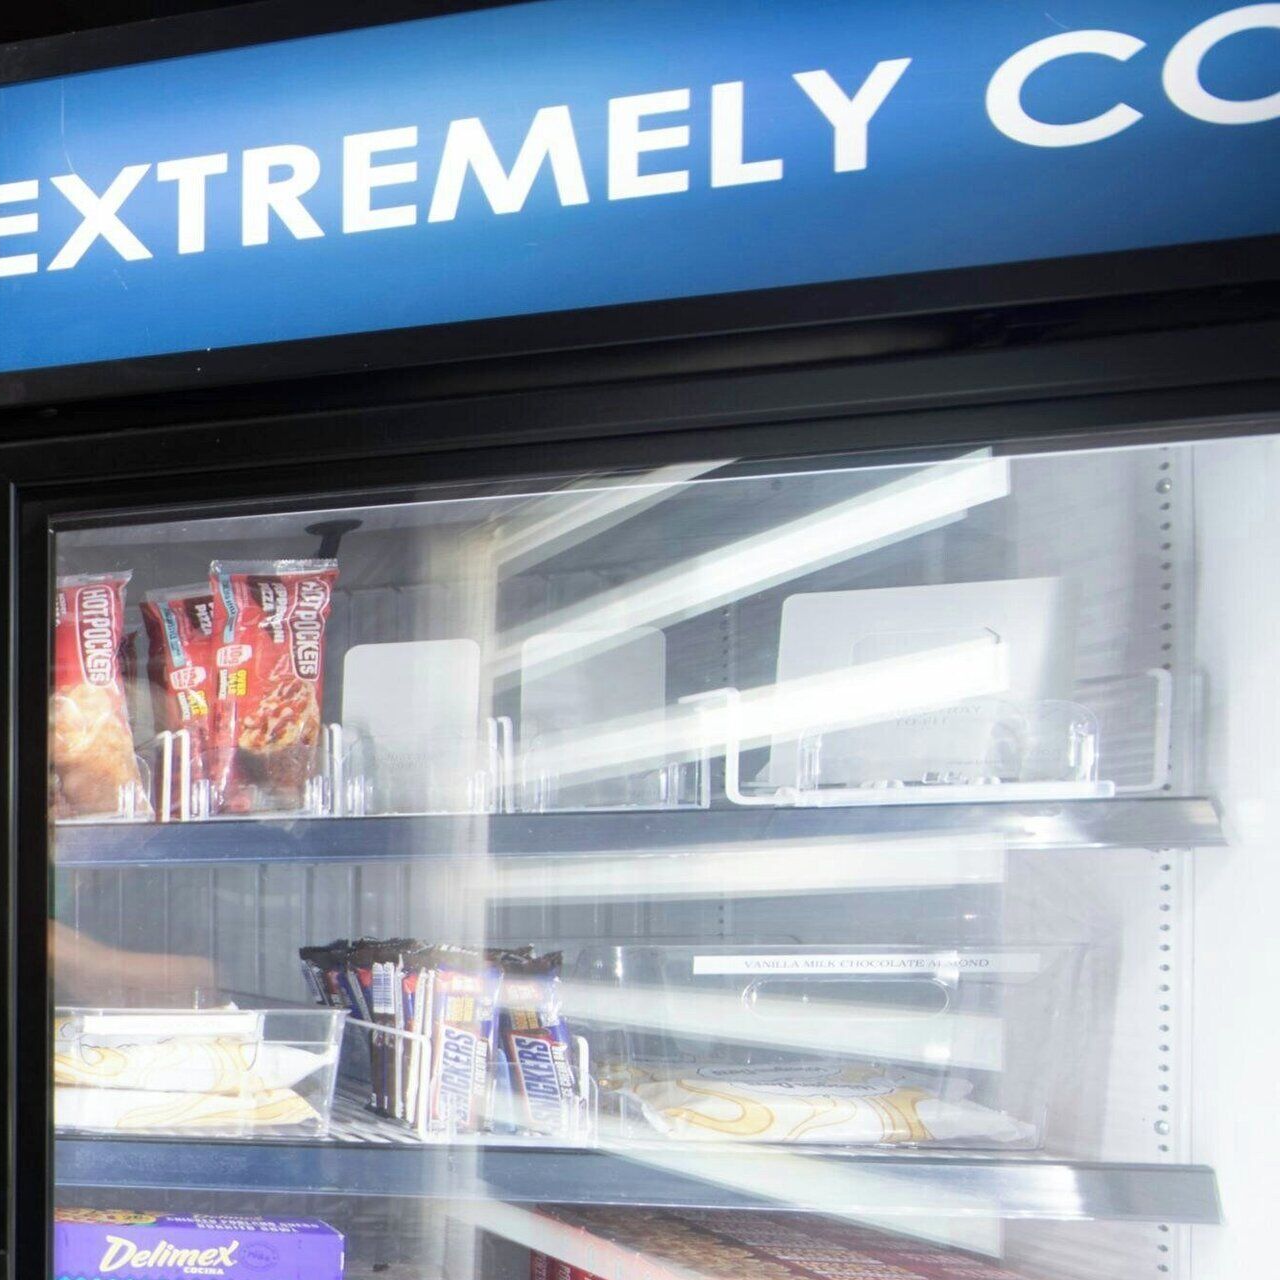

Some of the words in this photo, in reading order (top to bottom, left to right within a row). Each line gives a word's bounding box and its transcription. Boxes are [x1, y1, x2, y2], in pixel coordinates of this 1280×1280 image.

[82, 589, 105, 618] HOT
[258, 583, 274, 611] PIZZA
[300, 581, 324, 610] HOT
[195, 604, 212, 635] PIZZA
[84, 618, 113, 684] POCKETS
[293, 610, 320, 676] POCKETS
[744, 960, 801, 969] VANILLA
[802, 960, 836, 968] MILK
[840, 959, 925, 968] CHOCOLATE
[927, 958, 990, 968] ALOND
[99, 1235, 239, 1272] Delimex
[183, 1267, 224, 1275] COCINA
